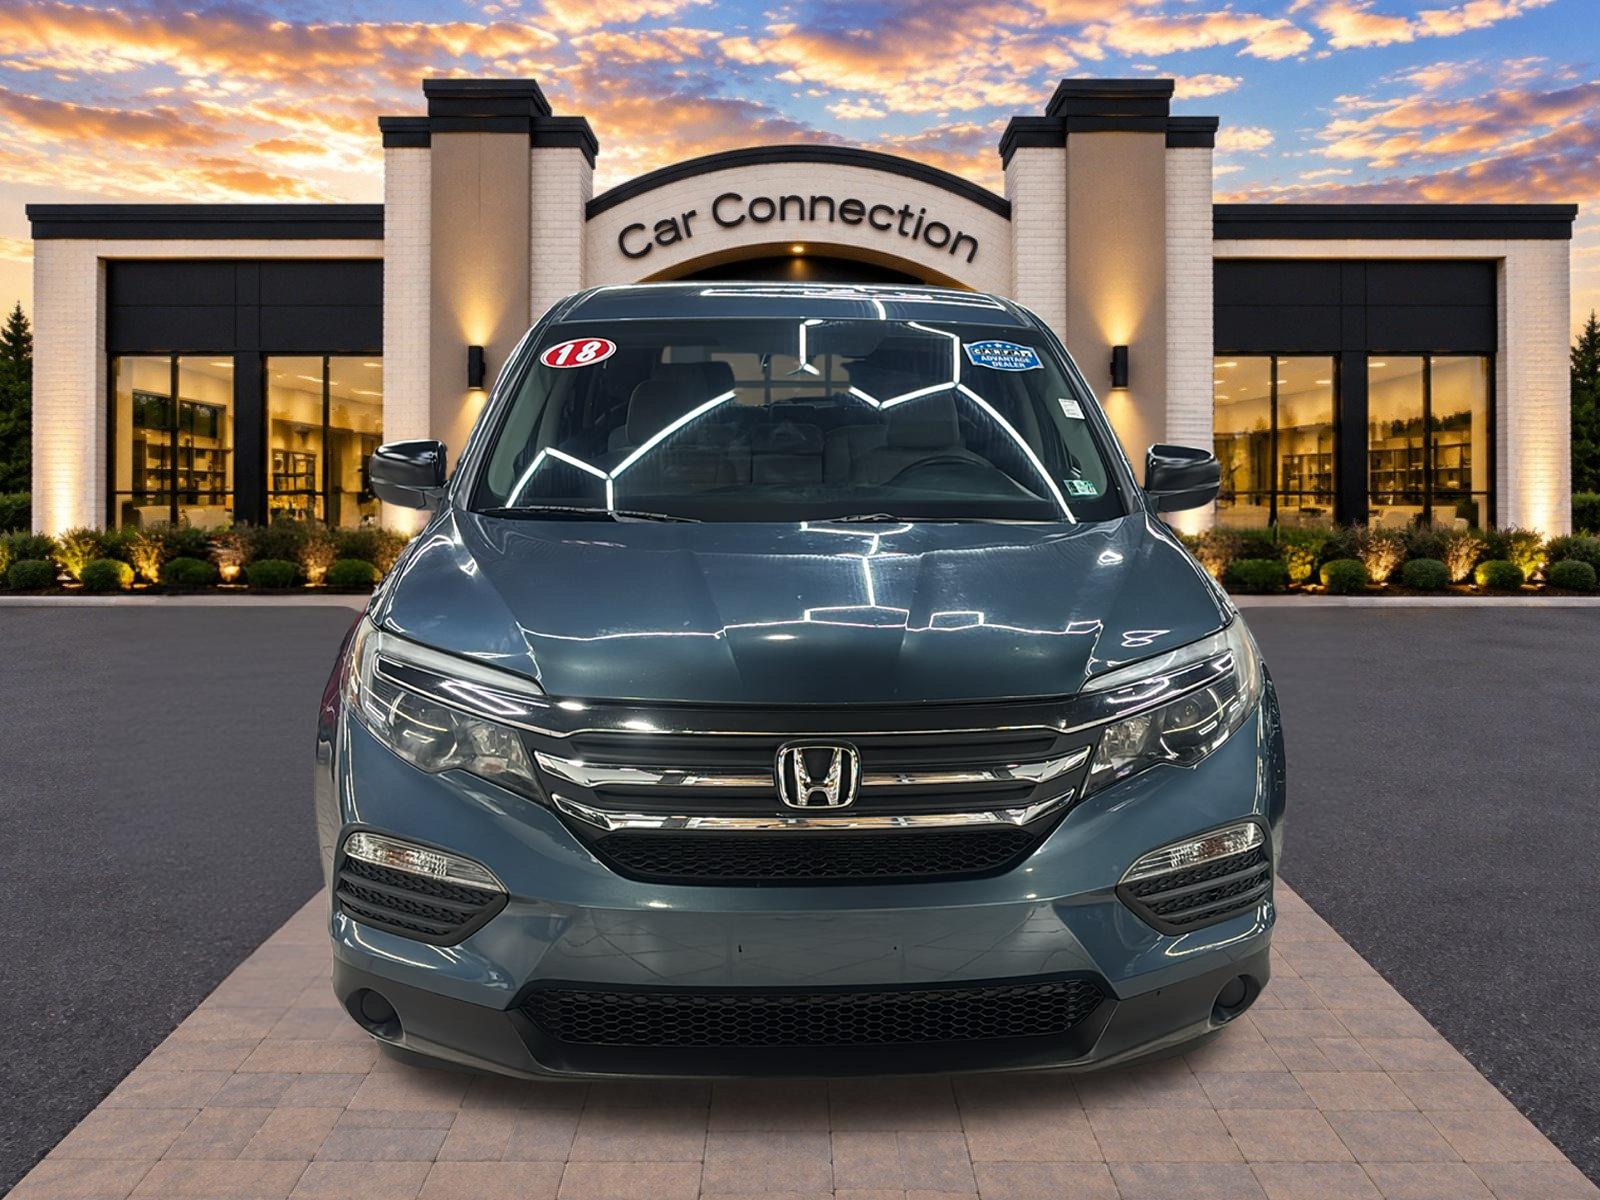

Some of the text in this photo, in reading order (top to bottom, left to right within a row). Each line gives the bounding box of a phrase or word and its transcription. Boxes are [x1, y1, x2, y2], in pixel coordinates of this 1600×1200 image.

[618, 192, 980, 264] Car Connection
[555, 341, 602, 365] 18
[981, 355, 1032, 363] ADVANTAGE
